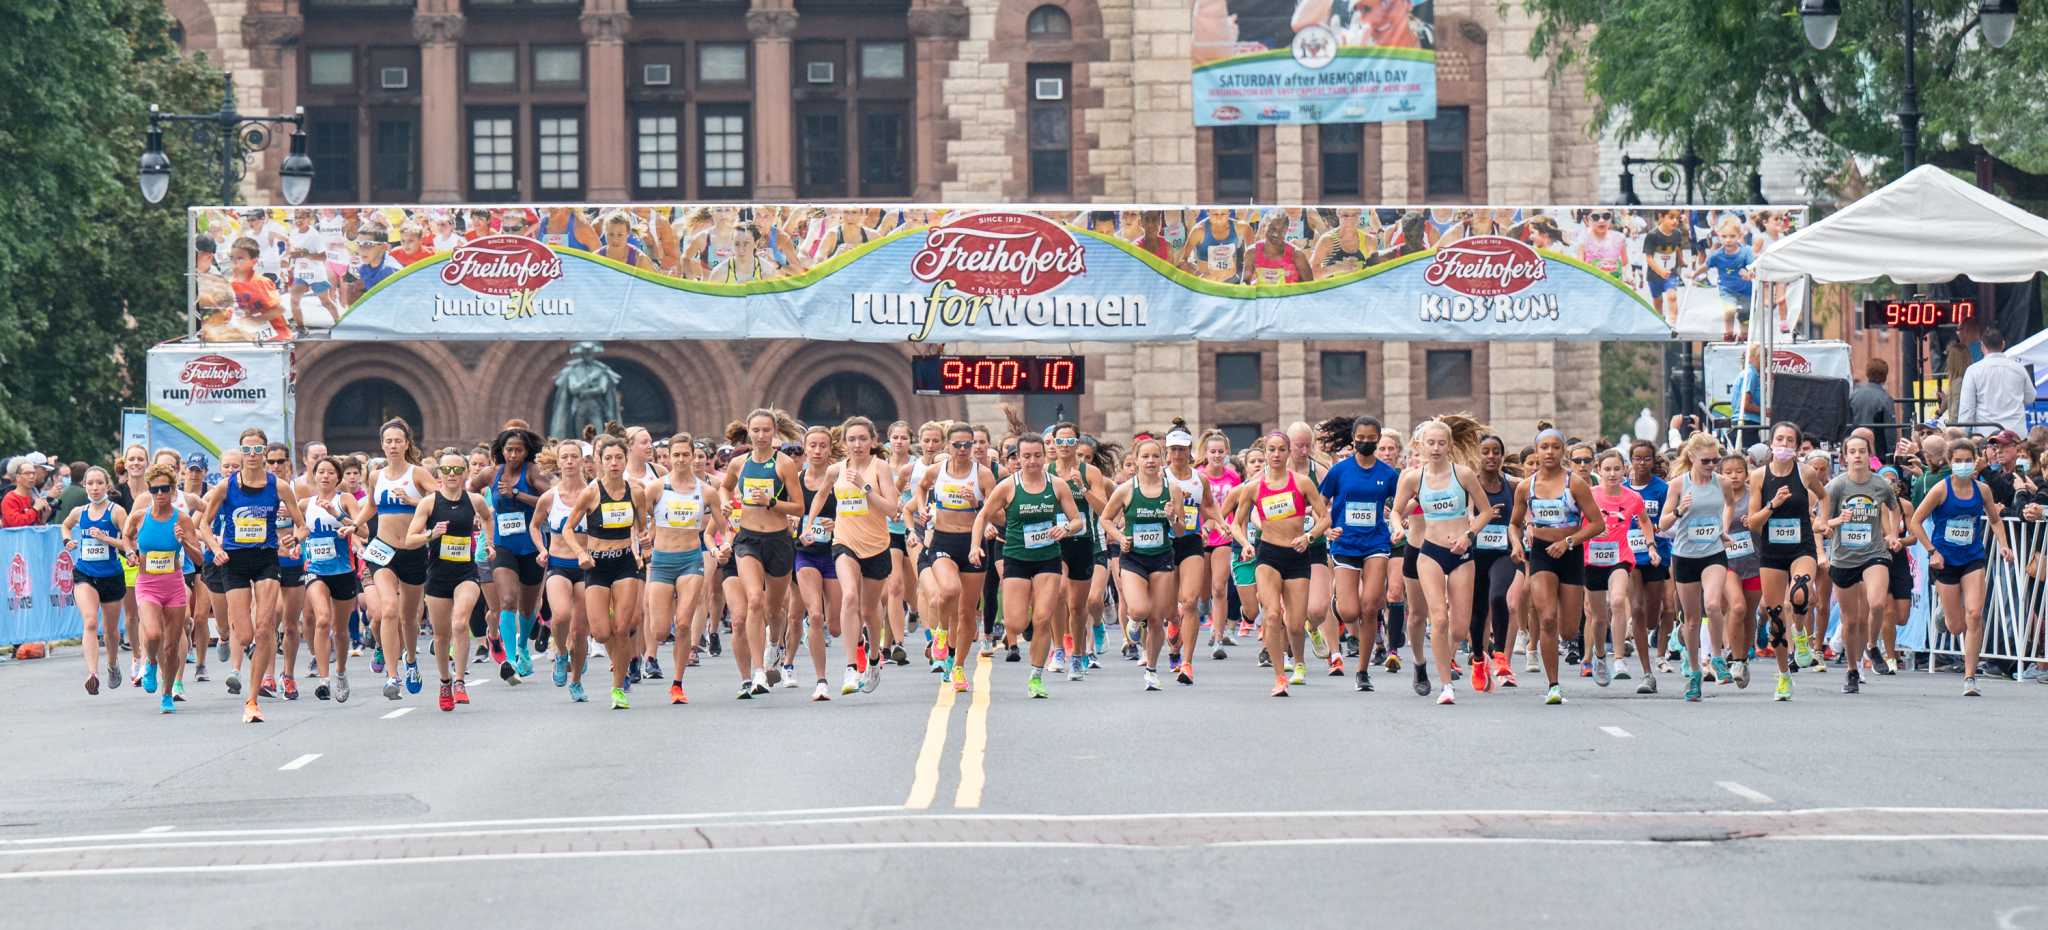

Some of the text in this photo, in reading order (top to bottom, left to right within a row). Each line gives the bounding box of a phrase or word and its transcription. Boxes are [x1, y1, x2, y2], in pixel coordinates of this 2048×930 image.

[1219, 70, 1408, 88] SATURDAY after MEMORIAL DAY
[978, 216, 1003, 224] SINCE
[911, 227, 1085, 286] Freihofer's
[441, 246, 563, 287] Freihofer's
[1424, 247, 1546, 288] Freihofer's
[977, 287, 1022, 296] BAKERY
[180, 360, 248, 384] Freihofer's
[1432, 502, 1454, 510] 1004
[1351, 511, 1372, 520] 1055
[1695, 527, 1716, 536] 1017
[1139, 533, 1160, 541] 1007
[1483, 534, 1504, 543] 1027
[1847, 532, 1867, 541] 1051
[1729, 541, 1750, 551] 1045
